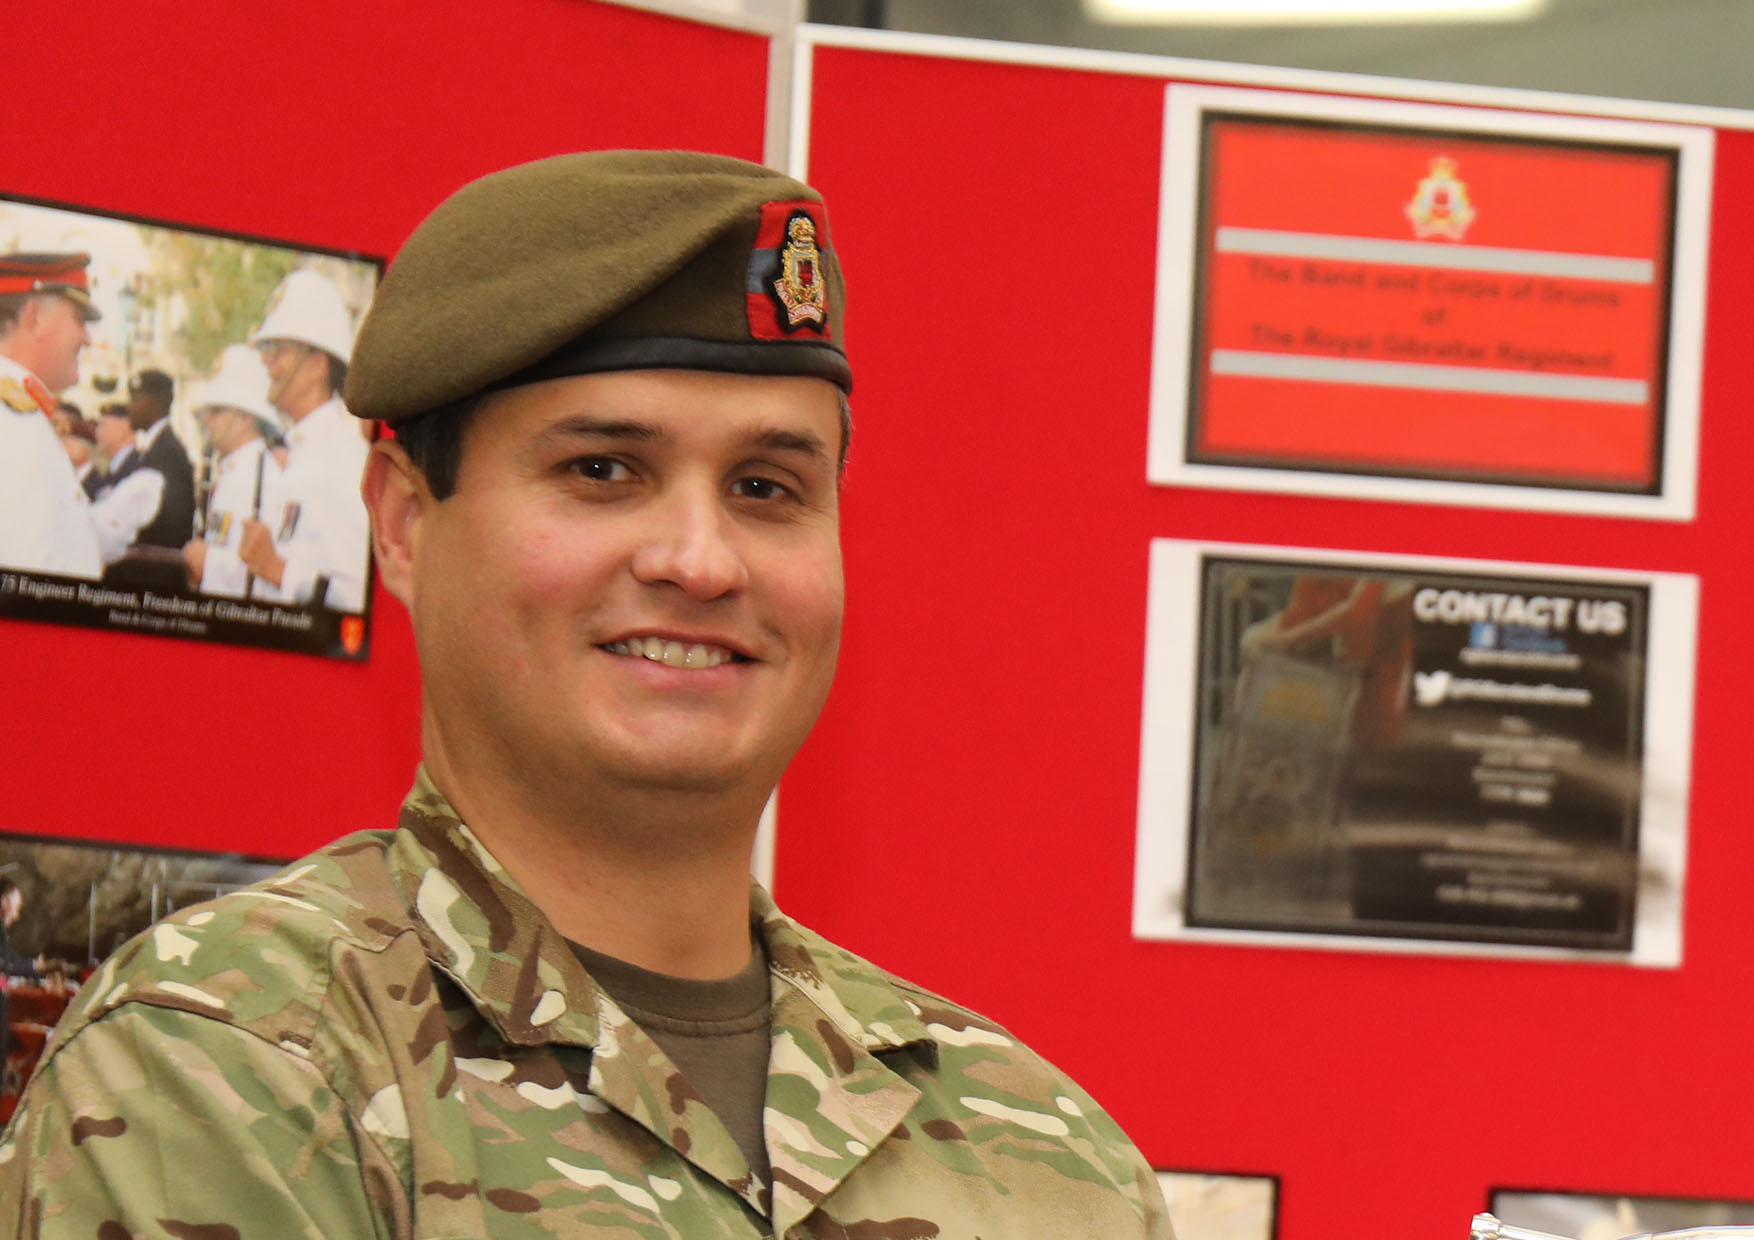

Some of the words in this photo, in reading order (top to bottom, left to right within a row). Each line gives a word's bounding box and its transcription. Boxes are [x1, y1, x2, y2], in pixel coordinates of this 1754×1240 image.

[1247, 261, 1292, 284] The
[1302, 264, 1366, 289] Band
[1375, 271, 1417, 293] and
[1427, 271, 1499, 301] Corps
[1509, 280, 1534, 301] of
[1542, 283, 1619, 308] Drums
[1423, 304, 1447, 326] of
[1252, 325, 1293, 348] The
[1304, 329, 1373, 357] Royal
[1383, 332, 1486, 361] Gibraltar
[1498, 342, 1613, 372] Regiment
[199, 597, 214, 616] of
[1414, 588, 1568, 632] CONTACT
[1577, 597, 1629, 637] US
